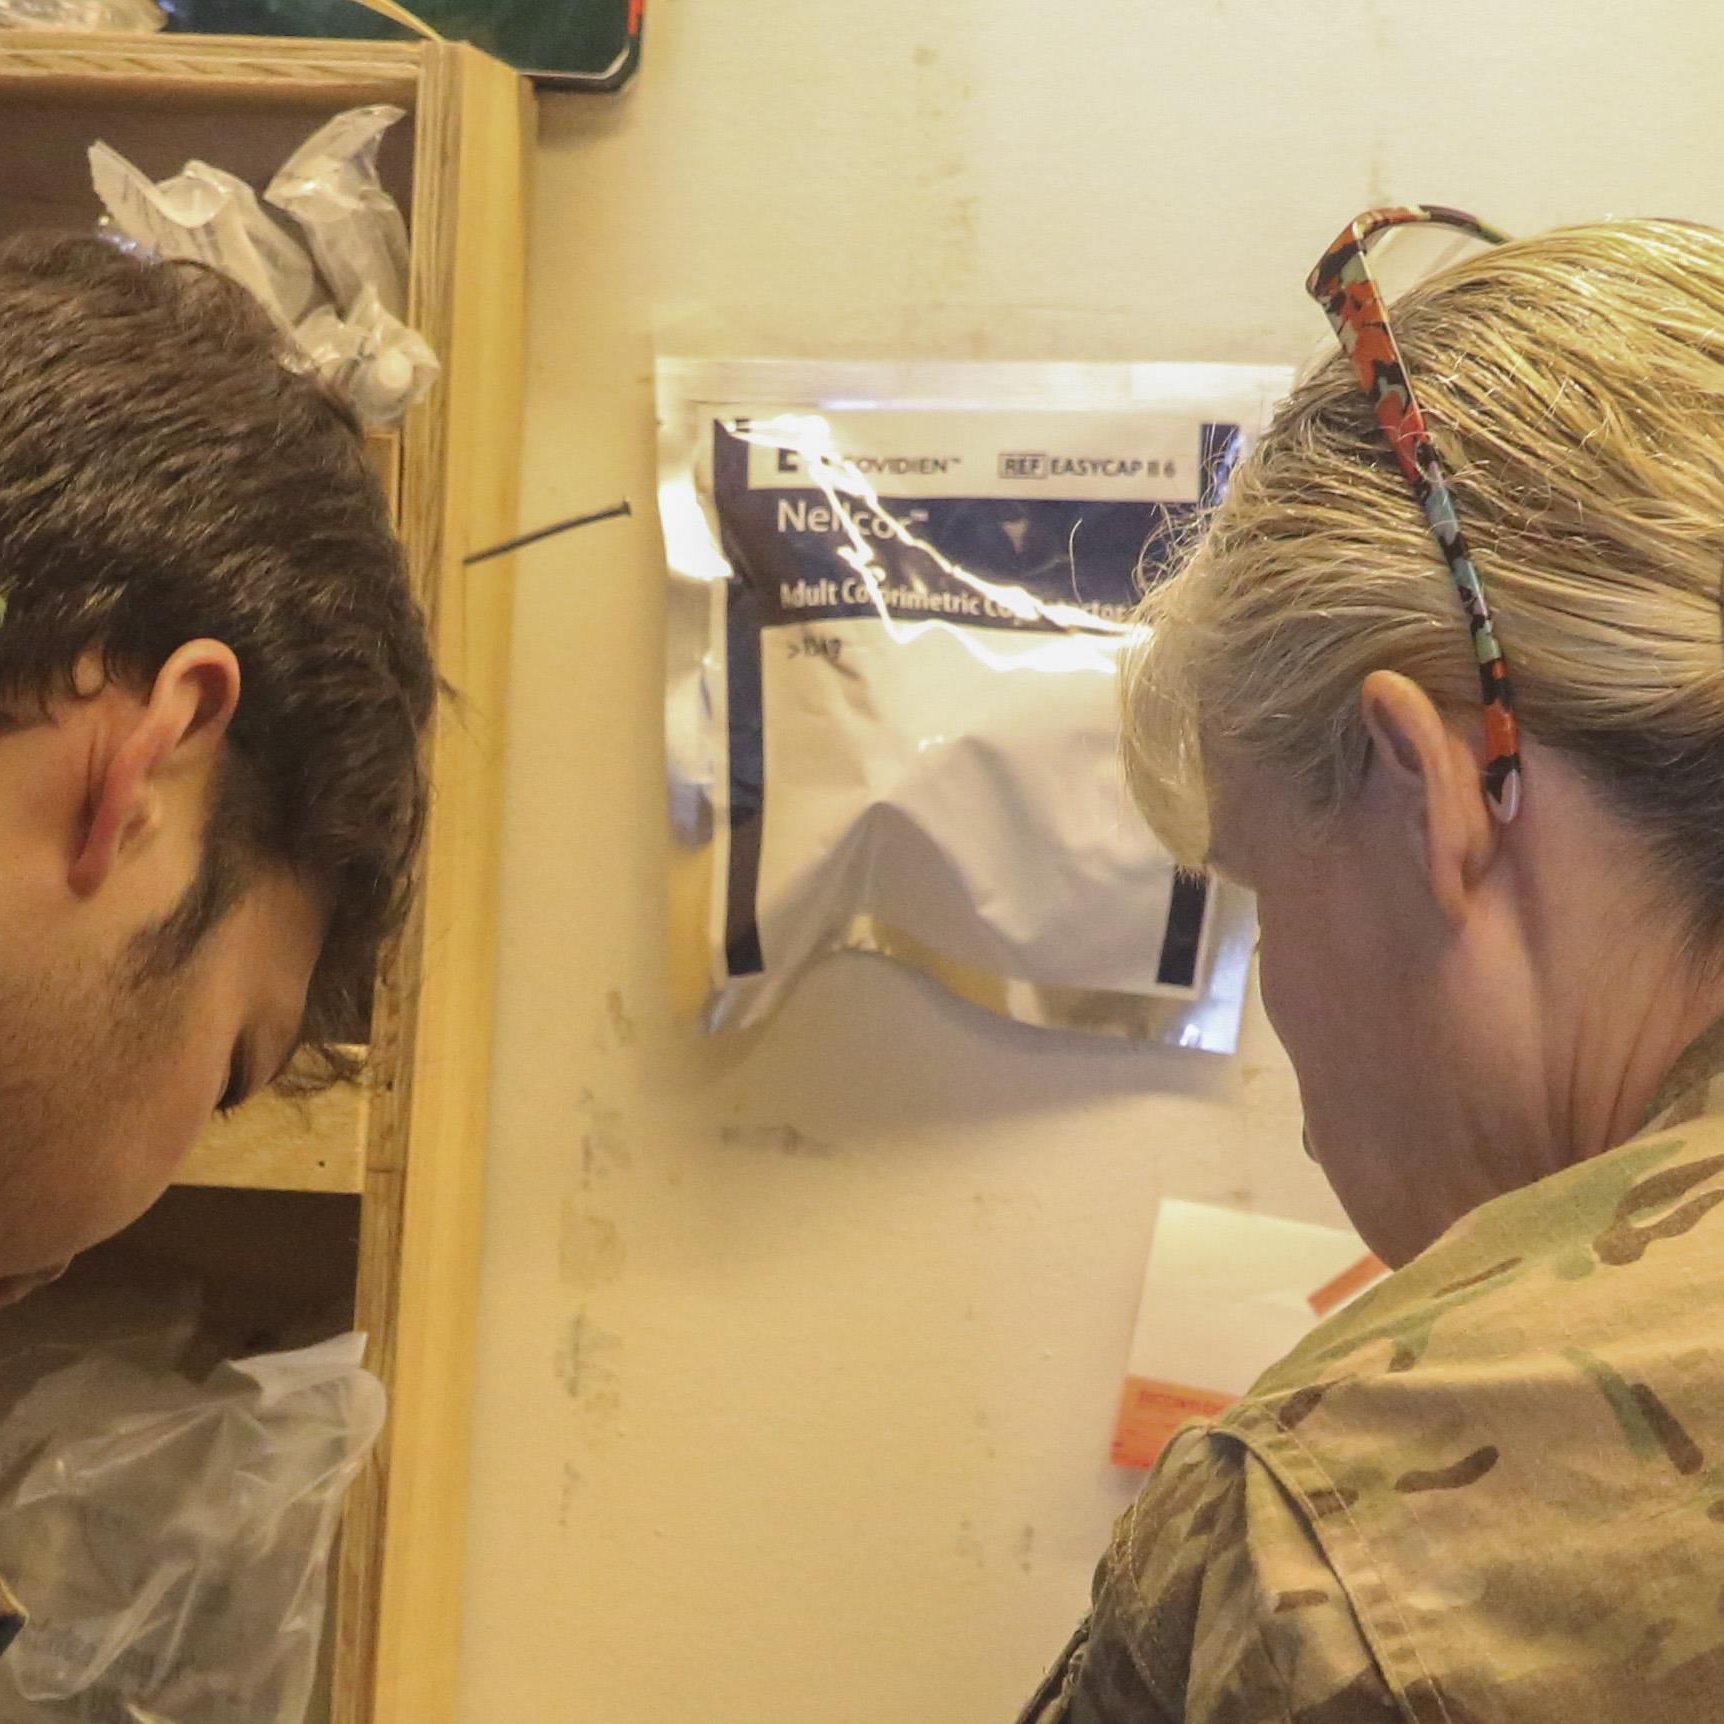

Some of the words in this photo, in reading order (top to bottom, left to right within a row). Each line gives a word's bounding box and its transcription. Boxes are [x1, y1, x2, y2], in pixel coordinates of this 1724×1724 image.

[1004, 457, 1040, 476] REF
[1050, 459, 1143, 477] EASYCAP
[841, 577, 981, 616] Coorimetric
